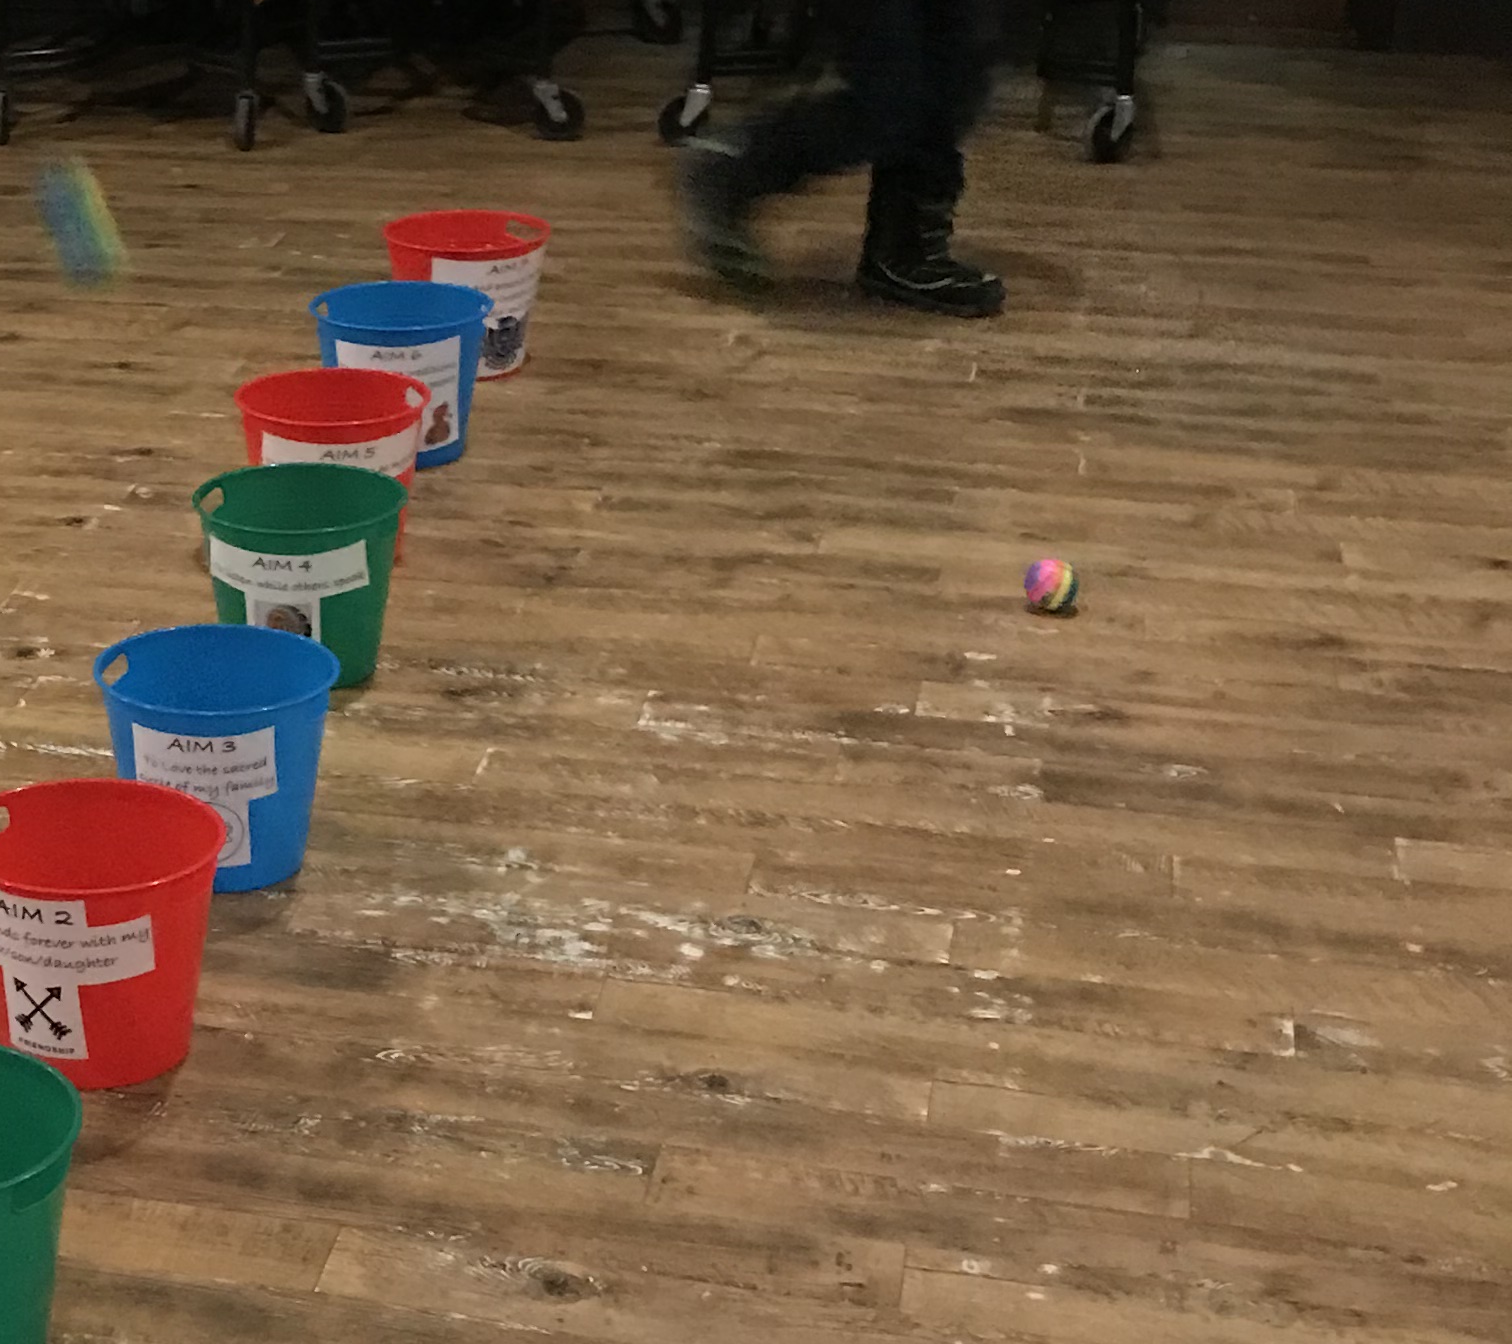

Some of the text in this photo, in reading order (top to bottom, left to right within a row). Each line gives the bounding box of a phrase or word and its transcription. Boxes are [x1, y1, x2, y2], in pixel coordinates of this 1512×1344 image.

[319, 447, 376, 461] AIM 5
[252, 556, 313, 573] AIM 4
[167, 738, 237, 753] AIM 3
[196, 763, 218, 776] the
[223, 756, 267, 774] sacred
[54, 910, 74, 926] 2
[22, 931, 76, 949] forever
[80, 934, 117, 949] with
[122, 927, 150, 944] my
[18, 1036, 75, 1055] FRIENDSHIP
